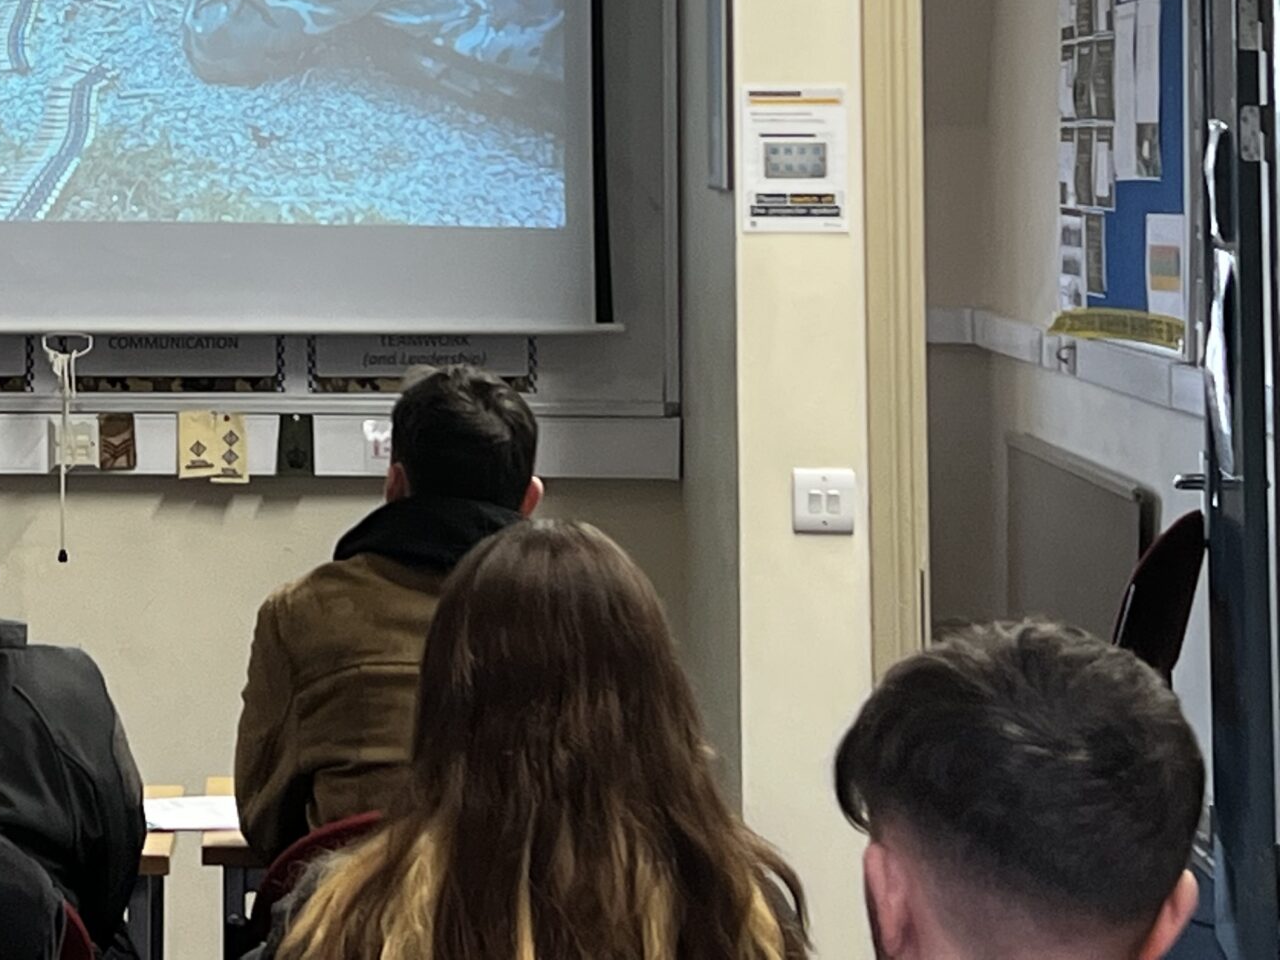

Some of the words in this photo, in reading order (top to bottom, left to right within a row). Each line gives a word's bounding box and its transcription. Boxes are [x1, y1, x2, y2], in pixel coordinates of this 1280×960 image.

[108, 336, 239, 350] COMMUNICATION
[380, 335, 470, 347] TEAMWORK
[362, 351, 396, 368] (and
